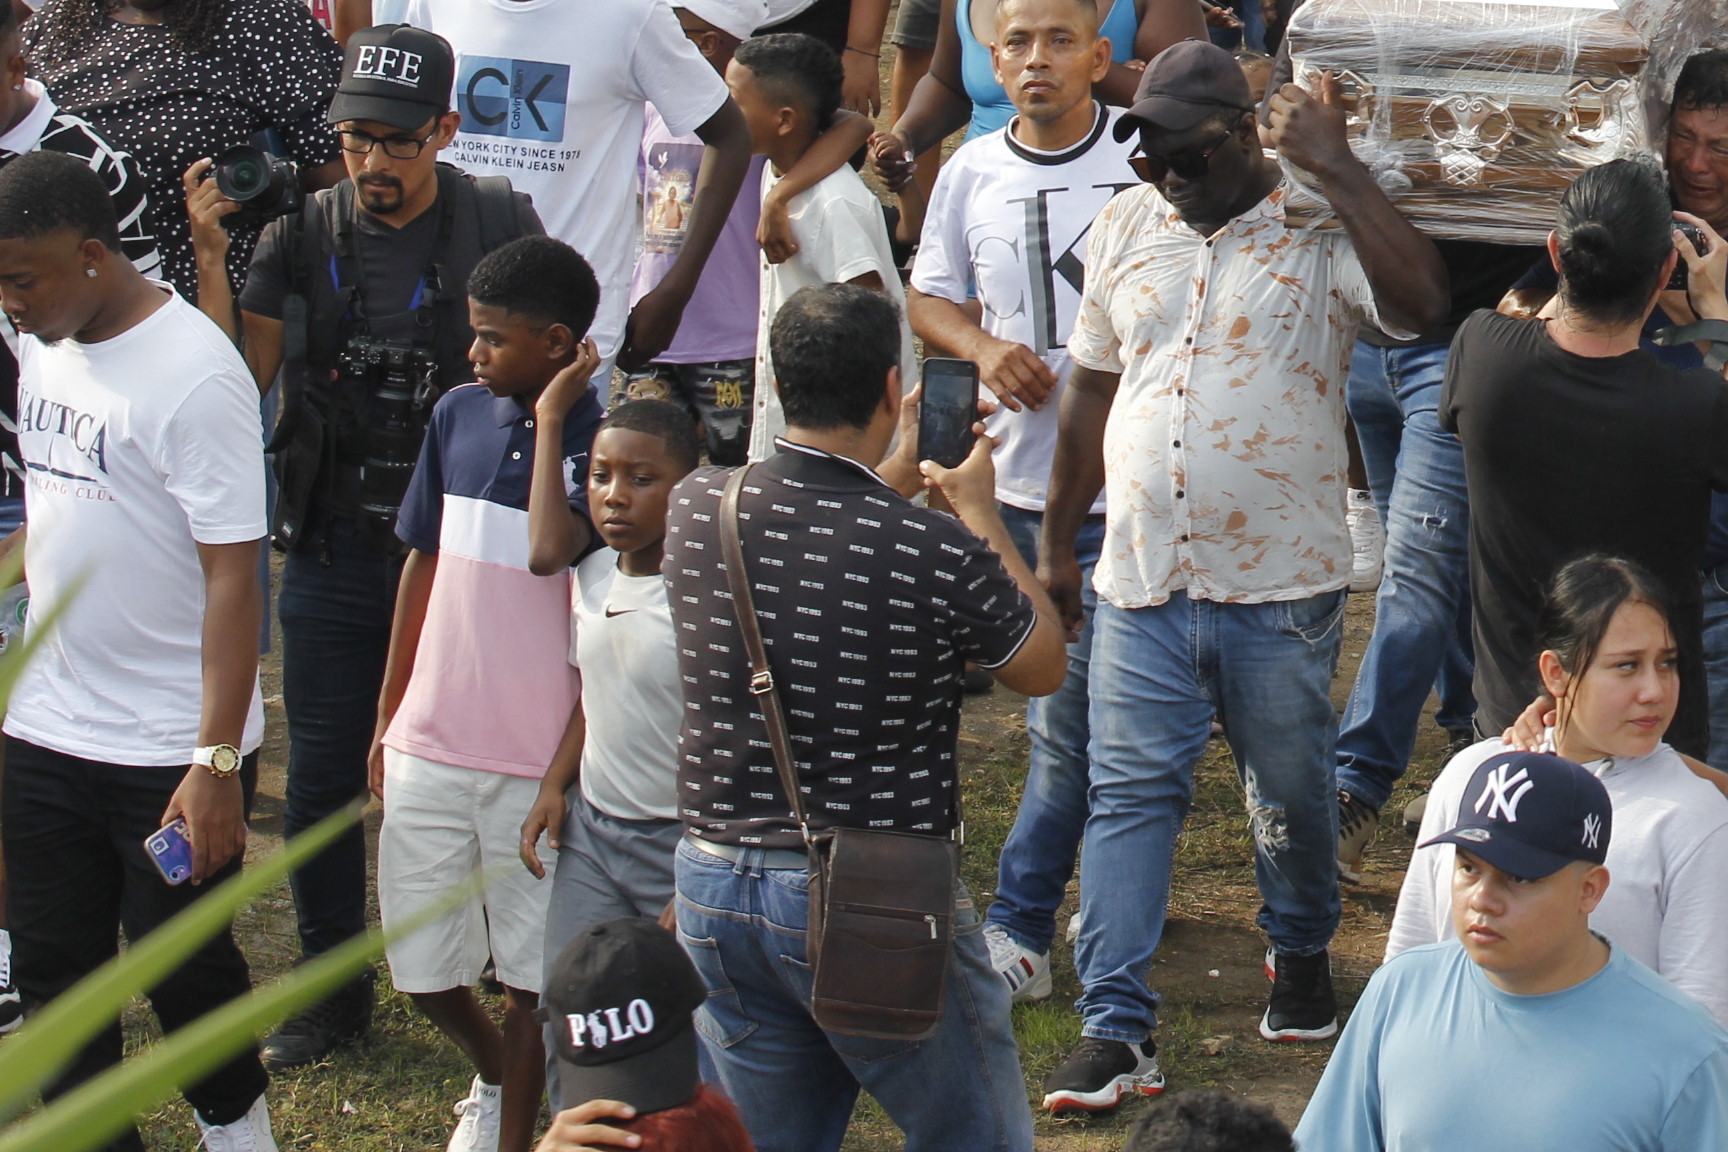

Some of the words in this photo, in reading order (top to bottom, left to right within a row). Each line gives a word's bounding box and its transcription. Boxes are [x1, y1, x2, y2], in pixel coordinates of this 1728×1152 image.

[353, 45, 423, 85] EFE
[466, 66, 555, 132] CK
[454, 151, 489, 165] CALVIN
[491, 157, 525, 169] KLEIN
[526, 161, 566, 174] JEASN
[461, 141, 491, 153] YORK
[492, 143, 517, 156] CITY
[521, 146, 557, 160] SINCE
[1473, 762, 1535, 824] NY
[1580, 811, 1602, 850] NY
